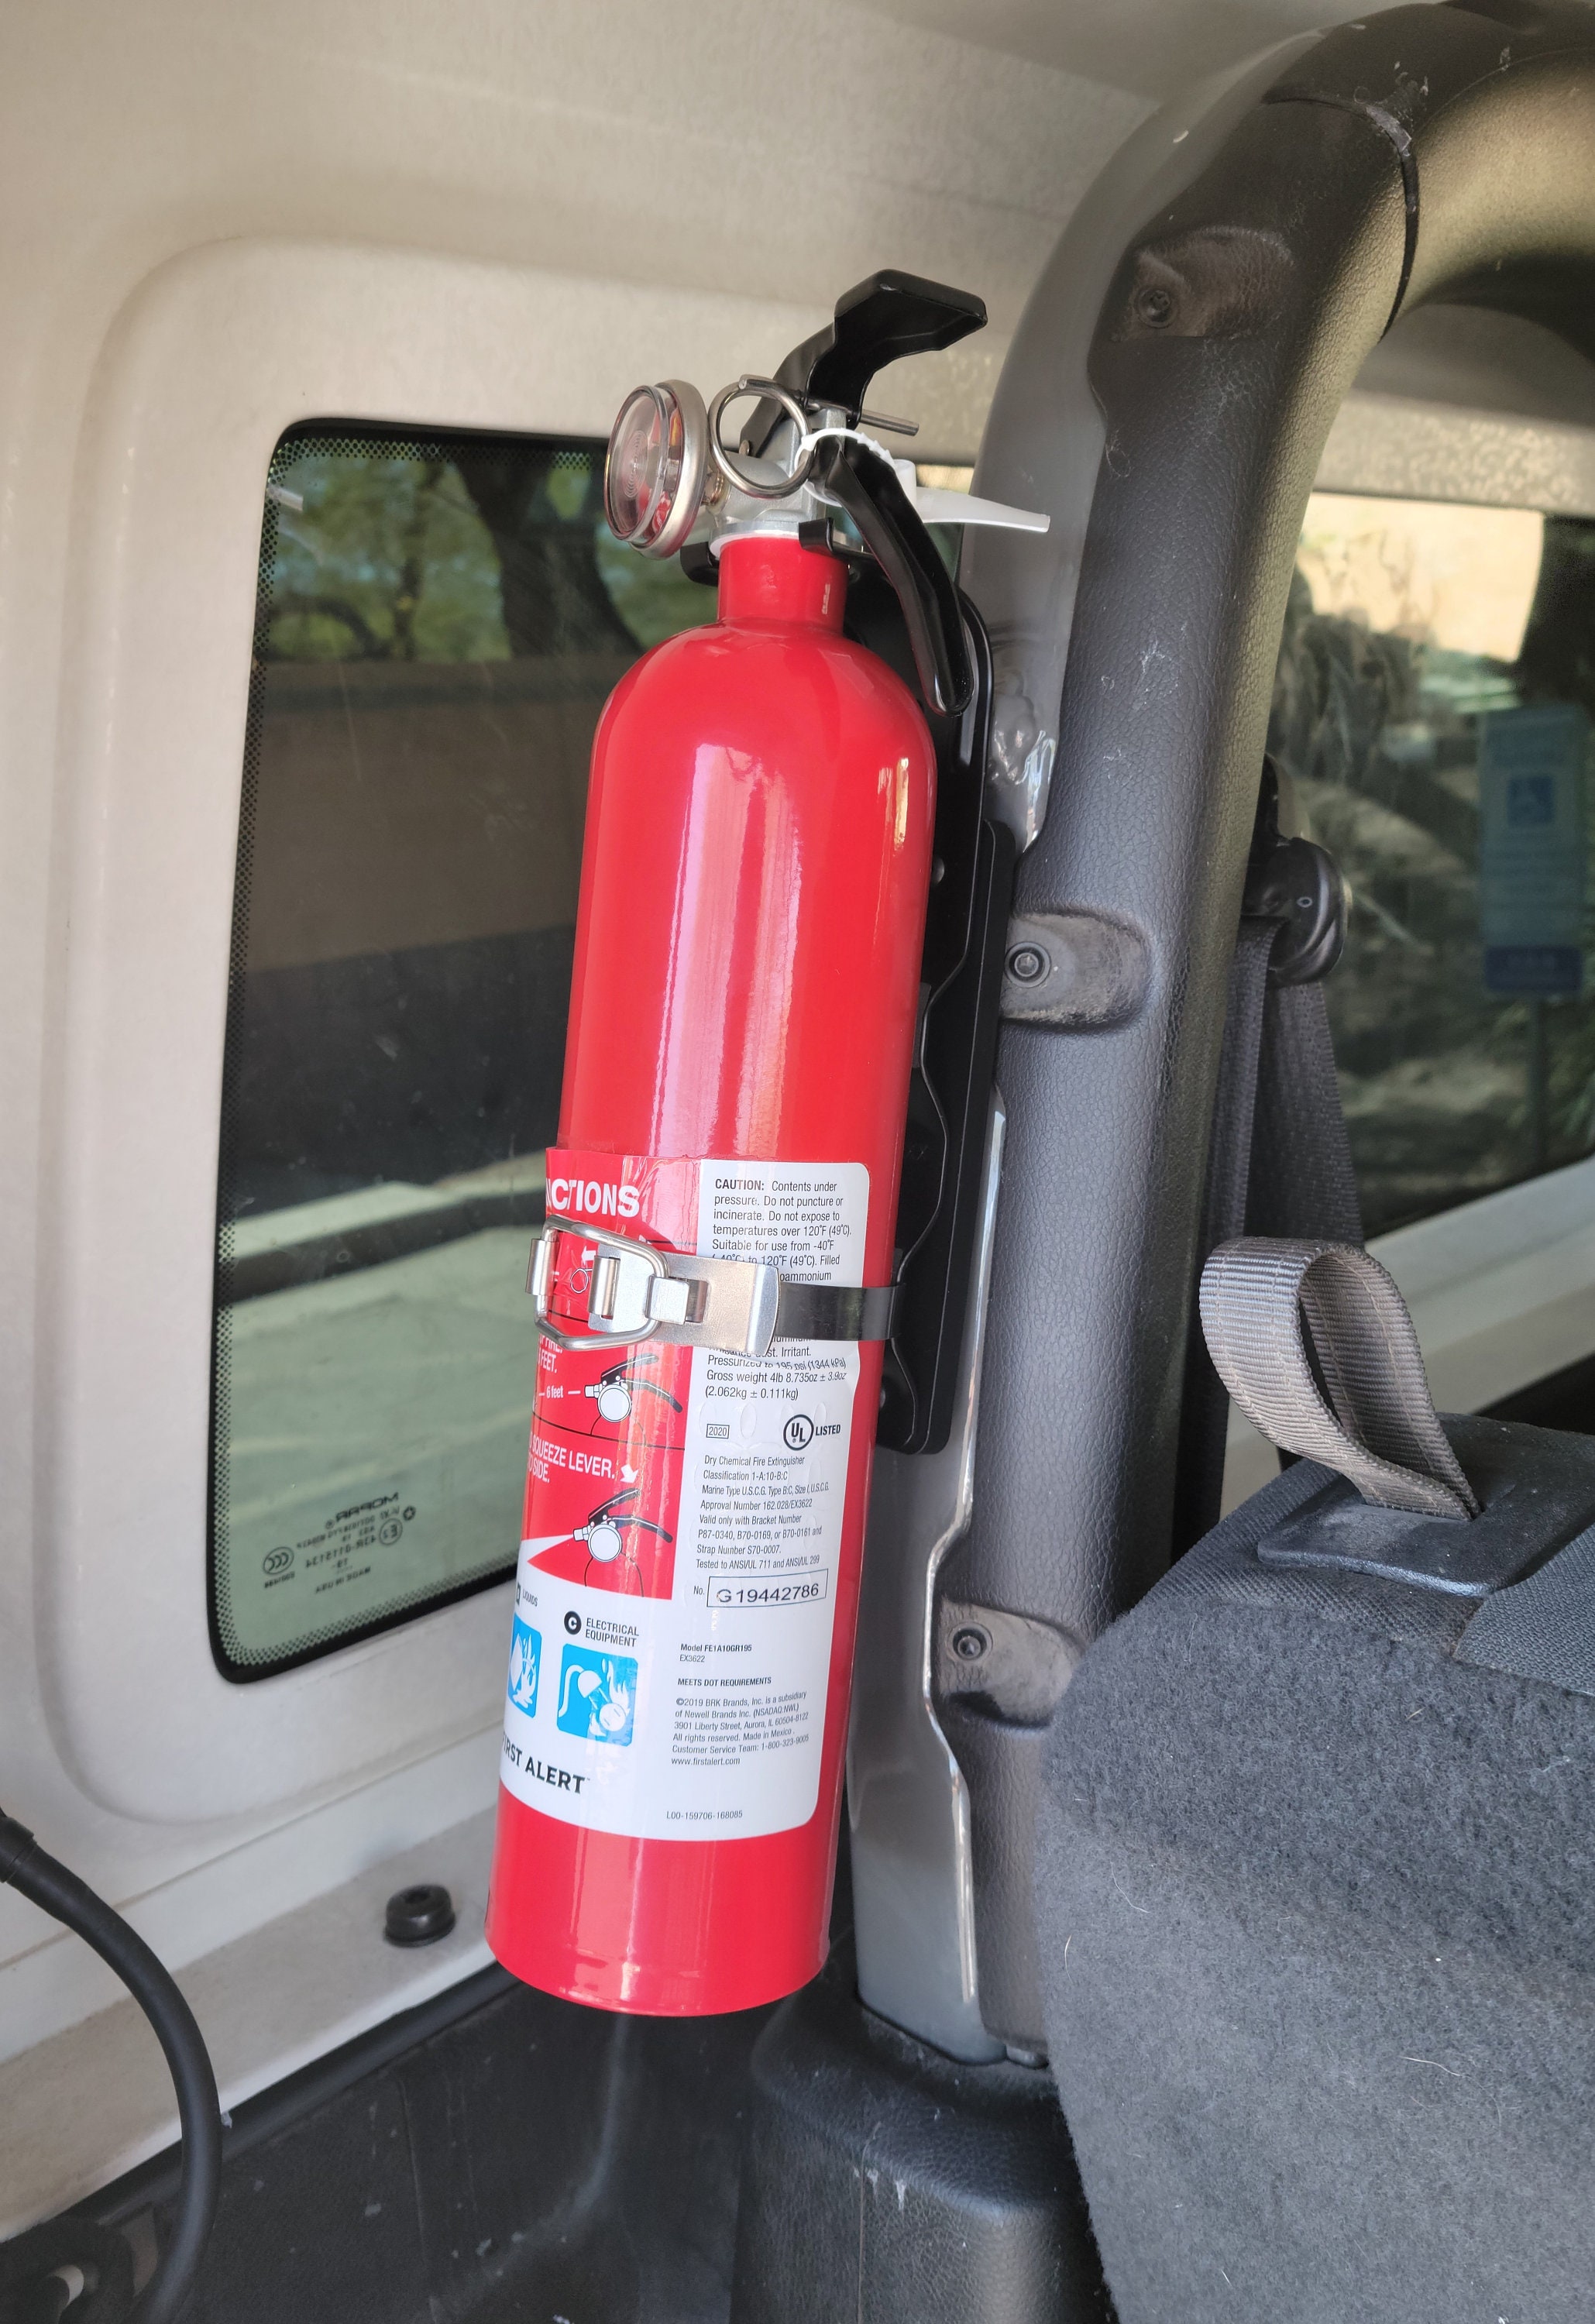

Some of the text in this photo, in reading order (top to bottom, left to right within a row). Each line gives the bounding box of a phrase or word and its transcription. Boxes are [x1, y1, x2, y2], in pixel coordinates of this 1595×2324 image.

[715, 1179, 837, 1192] CAUTION: Contents under
[545, 1177, 641, 1218] CTIONS
[714, 1195, 844, 1208] pressure. Do not puncture or
[713, 1209, 840, 1223] incinerate. Do not expose to
[713, 1224, 852, 1237] temperatures over 120°F (49°C).
[712, 1239, 834, 1251] Suitable for use from -40°F
[748, 1255, 758, 1264] to
[761, 1255, 788, 1267] 120°F
[789, 1255, 817, 1268] (49°C).
[820, 1255, 840, 1266] Filled
[781, 1346, 812, 1357] Irritant.
[794, 1360, 806, 1370] psi
[807, 1360, 830, 1370] (1344
[830, 1357, 847, 1368] kPa)
[706, 1369, 734, 1381] Gross
[737, 1372, 768, 1384] weight
[770, 1372, 783, 1383] 4lb
[785, 1373, 818, 1383] 8.735oz
[827, 1371, 847, 1381] 3.9oz
[546, 1385, 564, 1399] 6 feet
[705, 1386, 748, 1400] (2.062kg
[761, 1387, 799, 1401] 0.111kg)
[709, 1426, 727, 1436] 2020
[791, 1422, 806, 1442] UL
[815, 1425, 841, 1436] LISTED
[531, 1433, 567, 1468] SQUEEZE
[569, 1449, 616, 1480] LEVER.
[704, 1455, 805, 1469] Dry Chemical Fire Extinguisher
[533, 1456, 550, 1483] SIDE.
[703, 1470, 788, 1480] Classification 1-A:10-B:C
[702, 1484, 724, 1495] Marine
[726, 1486, 741, 1497] Type
[742, 1487, 767, 1496] U.S.C.G.
[768, 1487, 782, 1497] Type
[782, 1486, 794, 1496] B:C,
[795, 1484, 806, 1494] Size
[810, 1482, 830, 1494] U.S.C.G.
[700, 1499, 813, 1511] Approval Number 162.028/EX3622
[700, 1514, 802, 1527] Valid only with Bracket Number
[698, 1529, 735, 1541] P87-0340,
[737, 1531, 773, 1541] B70-0169,
[782, 1528, 810, 1539] B70-0161
[812, 1526, 822, 1535] and
[697, 1544, 782, 1556] Strap Number S70-0007.
[696, 1555, 820, 1569] Tested to ANSI/UL 711 and ANSI/UL 299
[693, 1586, 704, 1595] No.
[586, 1617, 640, 1637] ELECTRICAL
[585, 1628, 637, 1648] EQUIPMENT
[679, 1654, 705, 1662] EX3622
[677, 1677, 772, 1686] MEETS DOT REQUIREMENTS
[706, 1699, 720, 1707] BRK
[724, 1698, 749, 1707] Brands,
[751, 1697, 763, 1706] Inc.
[778, 1691, 807, 1702] subsidiary
[684, 1710, 710, 1718] Newell
[711, 1710, 737, 1718] Brands
[739, 1710, 751, 1718] Inc.
[695, 1722, 718, 1732] Liberty
[720, 1722, 742, 1731] Street,
[744, 1721, 766, 1730] Aurora,
[775, 1712, 809, 1726] 60504-8122
[672, 1733, 682, 1741] All
[684, 1734, 706, 1744] rights
[707, 1734, 741, 1742] reserved.
[743, 1733, 761, 1741] Made
[672, 1734, 810, 1754] Customer Service Team: 1-800-323-9005
